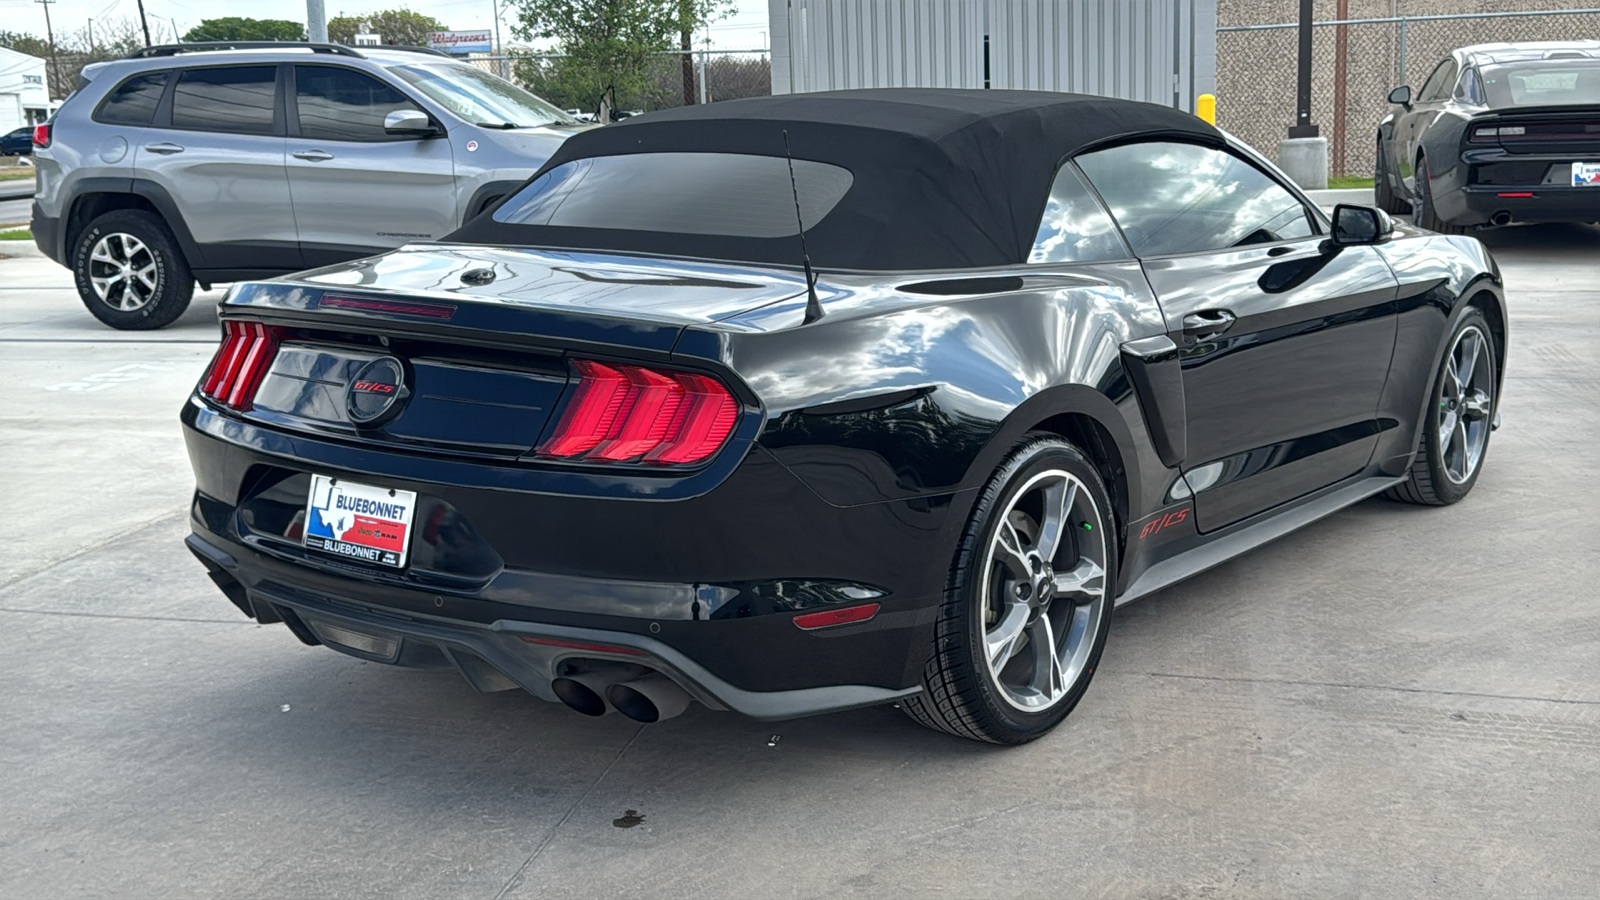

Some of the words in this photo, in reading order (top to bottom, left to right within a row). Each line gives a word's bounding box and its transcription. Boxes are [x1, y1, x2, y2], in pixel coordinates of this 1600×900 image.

[432, 32, 488, 46] Walgreens
[376, 231, 432, 239] CHEROKEE
[354, 382, 395, 393] GT/CS
[336, 495, 406, 520] BLUEBONNET
[1139, 507, 1191, 540] GT/CS
[323, 540, 381, 560] BLUEBONNET
